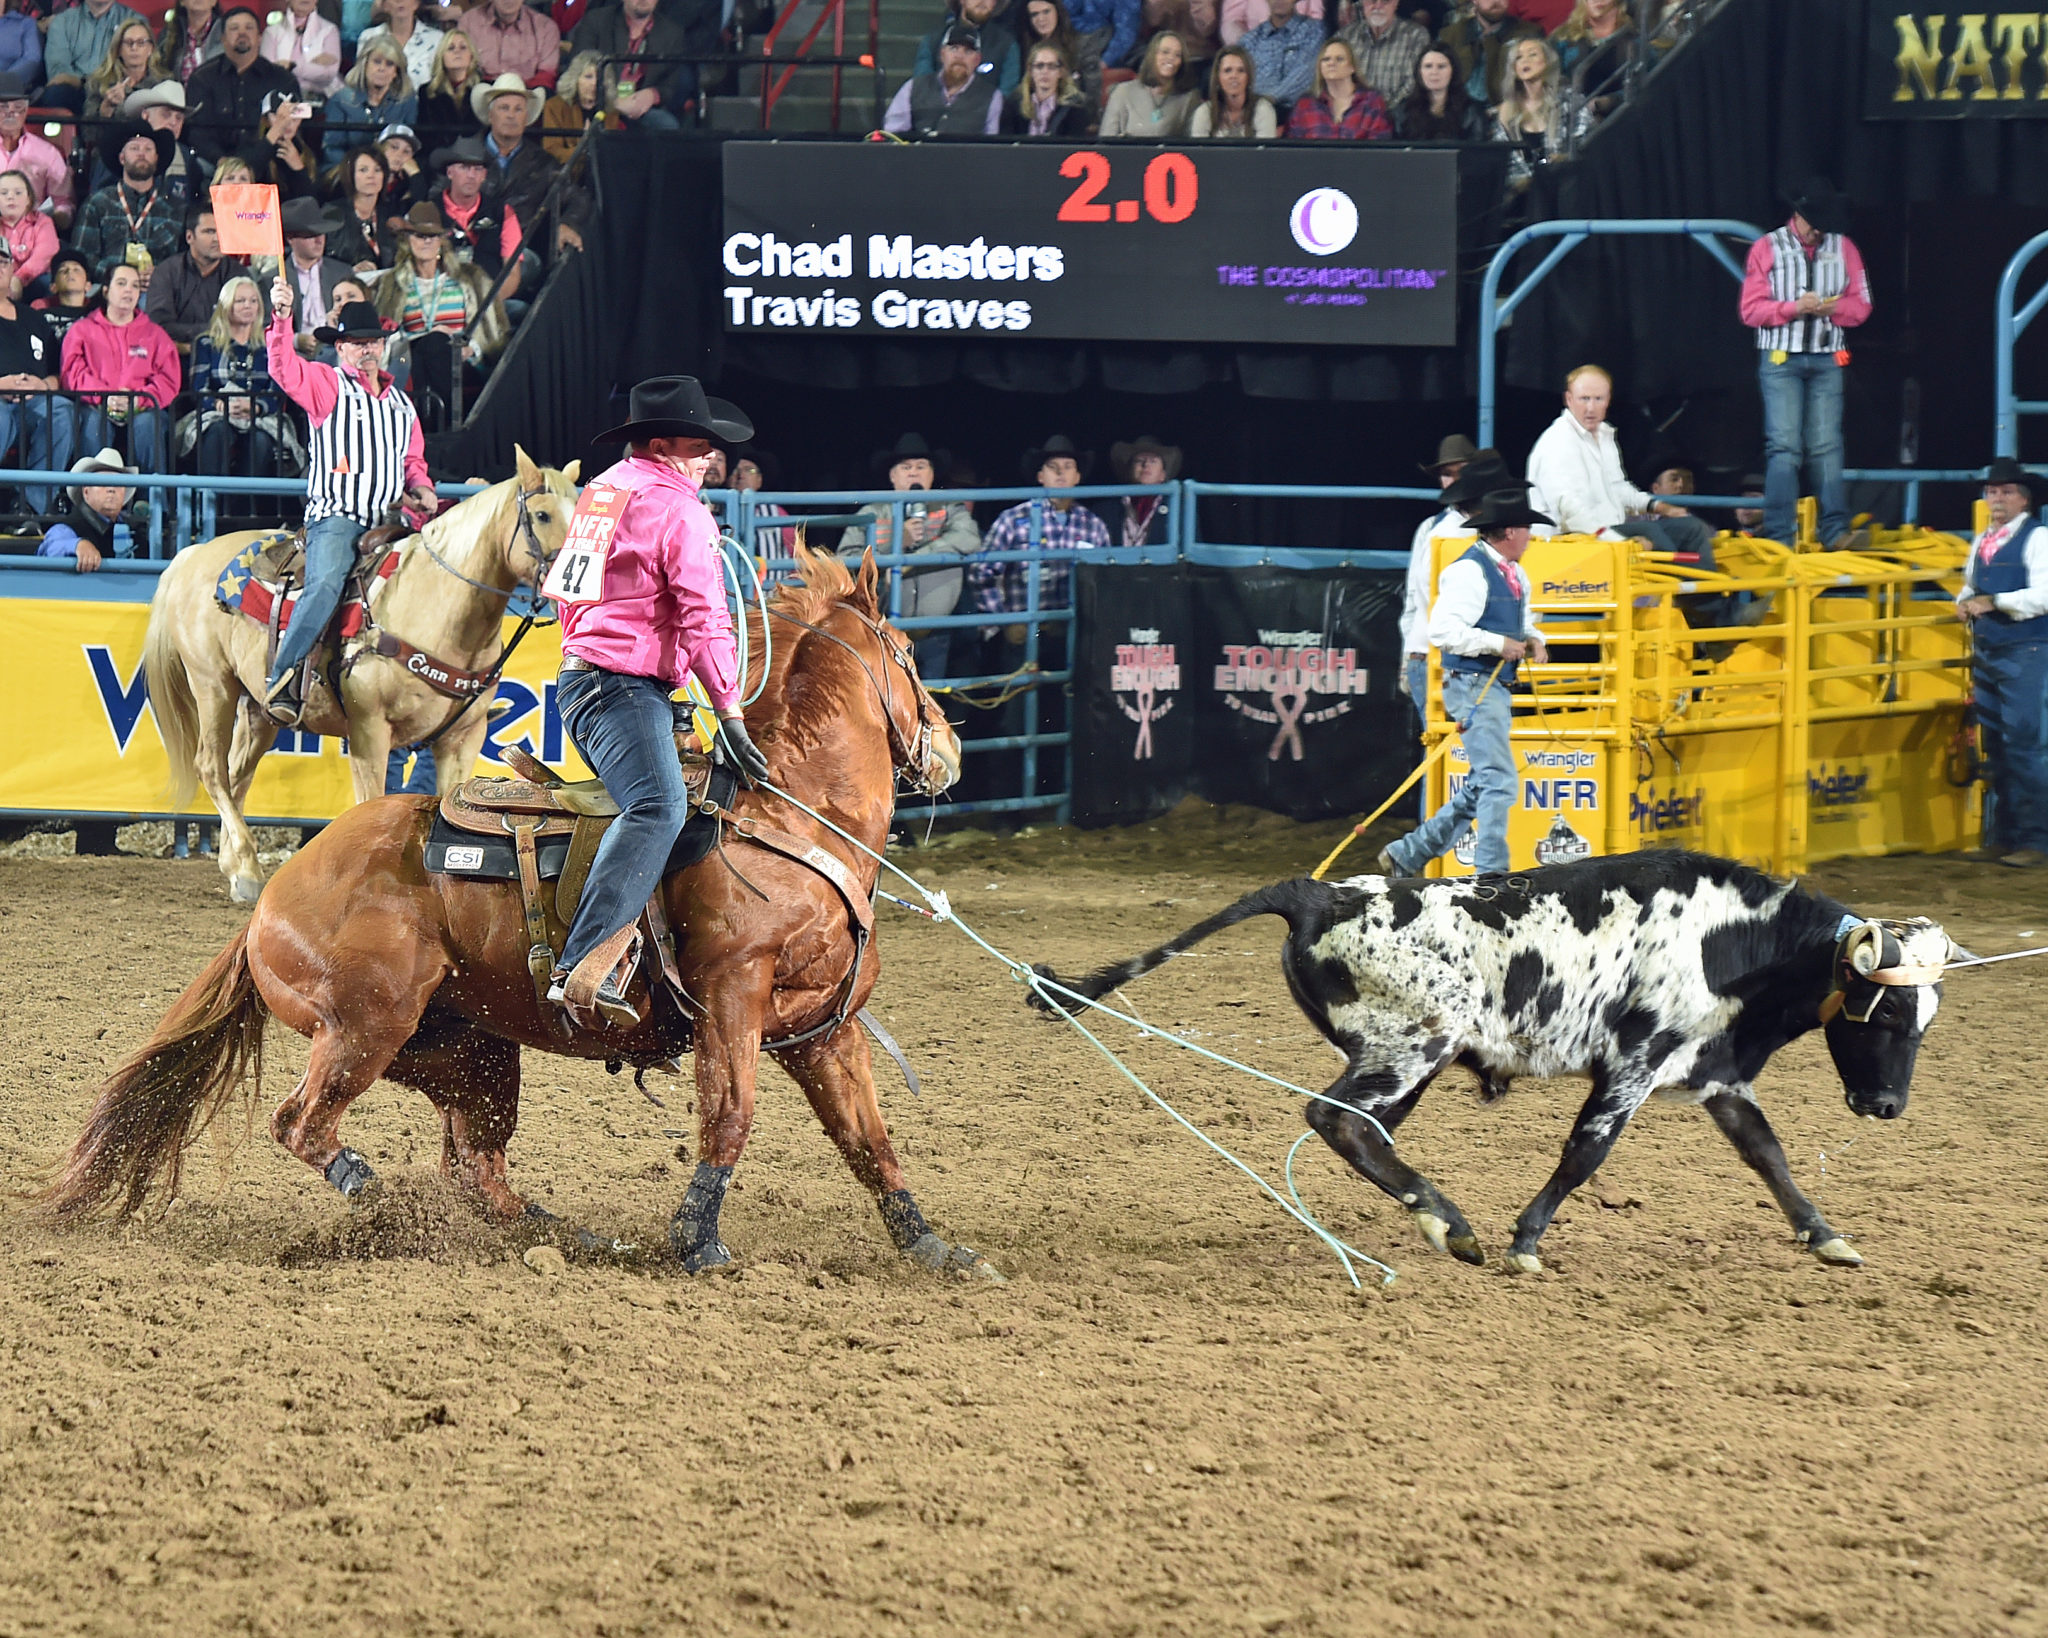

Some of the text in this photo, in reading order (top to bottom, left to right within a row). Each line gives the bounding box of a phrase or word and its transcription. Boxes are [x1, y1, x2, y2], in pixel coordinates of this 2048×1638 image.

[1056, 151, 1199, 223] 2.0
[722, 231, 1064, 281] Chad Masters
[1216, 265, 1259, 286] THE
[723, 286, 1032, 331] Travis Graves
[568, 513, 615, 541] NFR
[562, 554, 590, 594] 47
[1542, 580, 1610, 594] Priefert
[407, 653, 449, 683] CARR
[1115, 644, 1175, 668] TOUGH
[1223, 645, 1357, 672] TOUGH
[1214, 664, 1369, 694] ENOUGH
[1525, 751, 1597, 774] Wrangler
[1524, 779, 1598, 810] NFR
[447, 852, 480, 864] CSI
